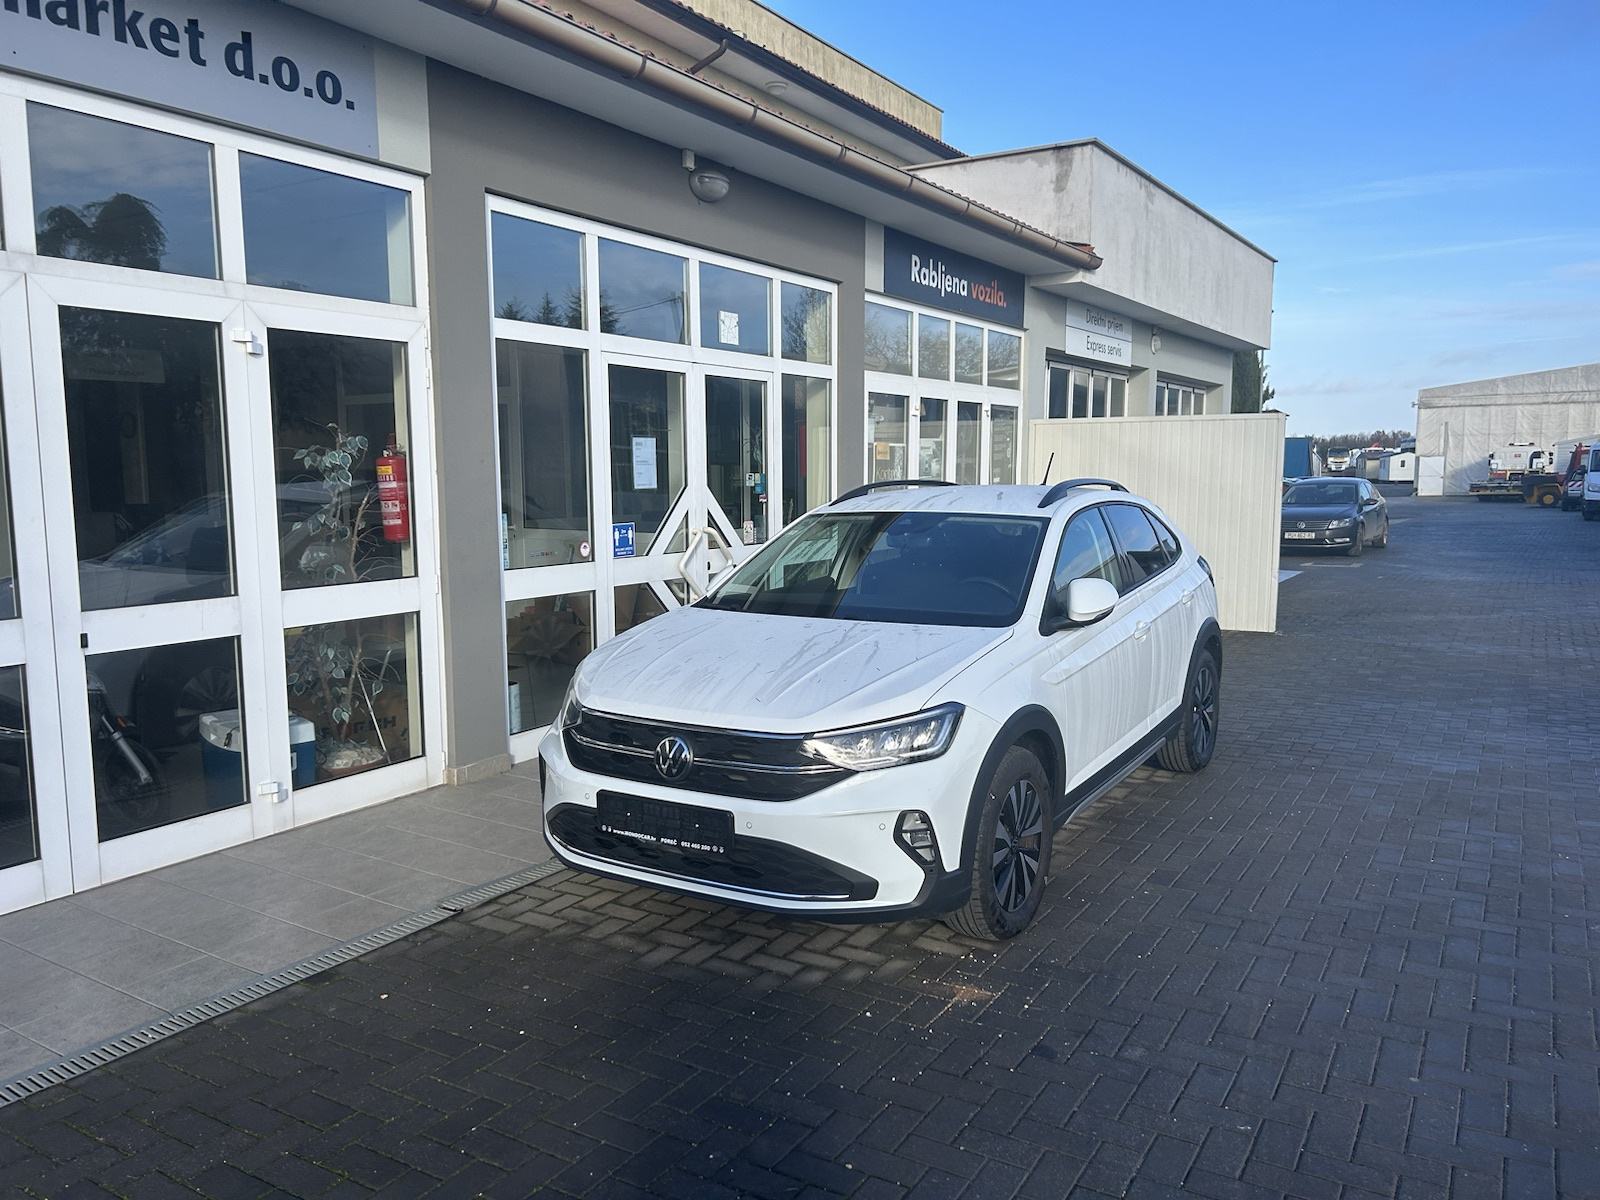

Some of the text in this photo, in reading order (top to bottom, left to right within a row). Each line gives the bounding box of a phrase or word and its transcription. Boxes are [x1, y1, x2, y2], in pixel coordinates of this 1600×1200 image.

[224, 31, 356, 111] d.o.o.
[911, 254, 1007, 308] Rabljena vozila.
[1086, 308, 1123, 334] Direktni prijem
[1086, 335, 1122, 357] Express servis
